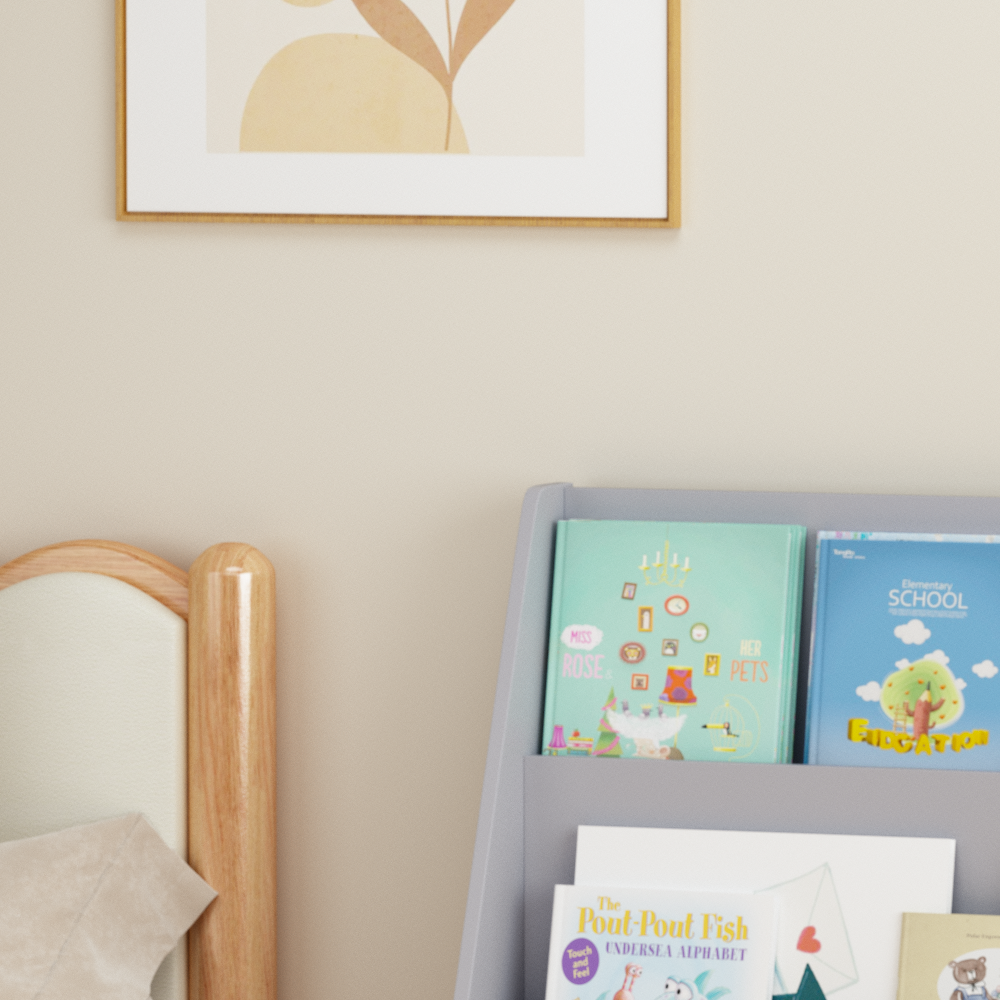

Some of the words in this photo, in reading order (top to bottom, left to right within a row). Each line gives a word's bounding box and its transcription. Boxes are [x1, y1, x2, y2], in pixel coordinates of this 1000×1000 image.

[902, 578, 954, 592] Elementary
[888, 589, 969, 610] SCHOOL
[570, 630, 592, 644] MISS
[740, 639, 762, 657] HER
[562, 653, 605, 679] ROSE
[730, 660, 769, 683] PETS
[597, 896, 621, 911] The
[576, 906, 695, 940] Pout-Pout
[700, 913, 750, 943] Fish
[567, 945, 593, 960] Touch
[605, 941, 673, 958] UNDERSEA
[677, 945, 748, 962] ALPHABET
[572, 959, 589, 969] and
[573, 968, 590, 980] Feel
